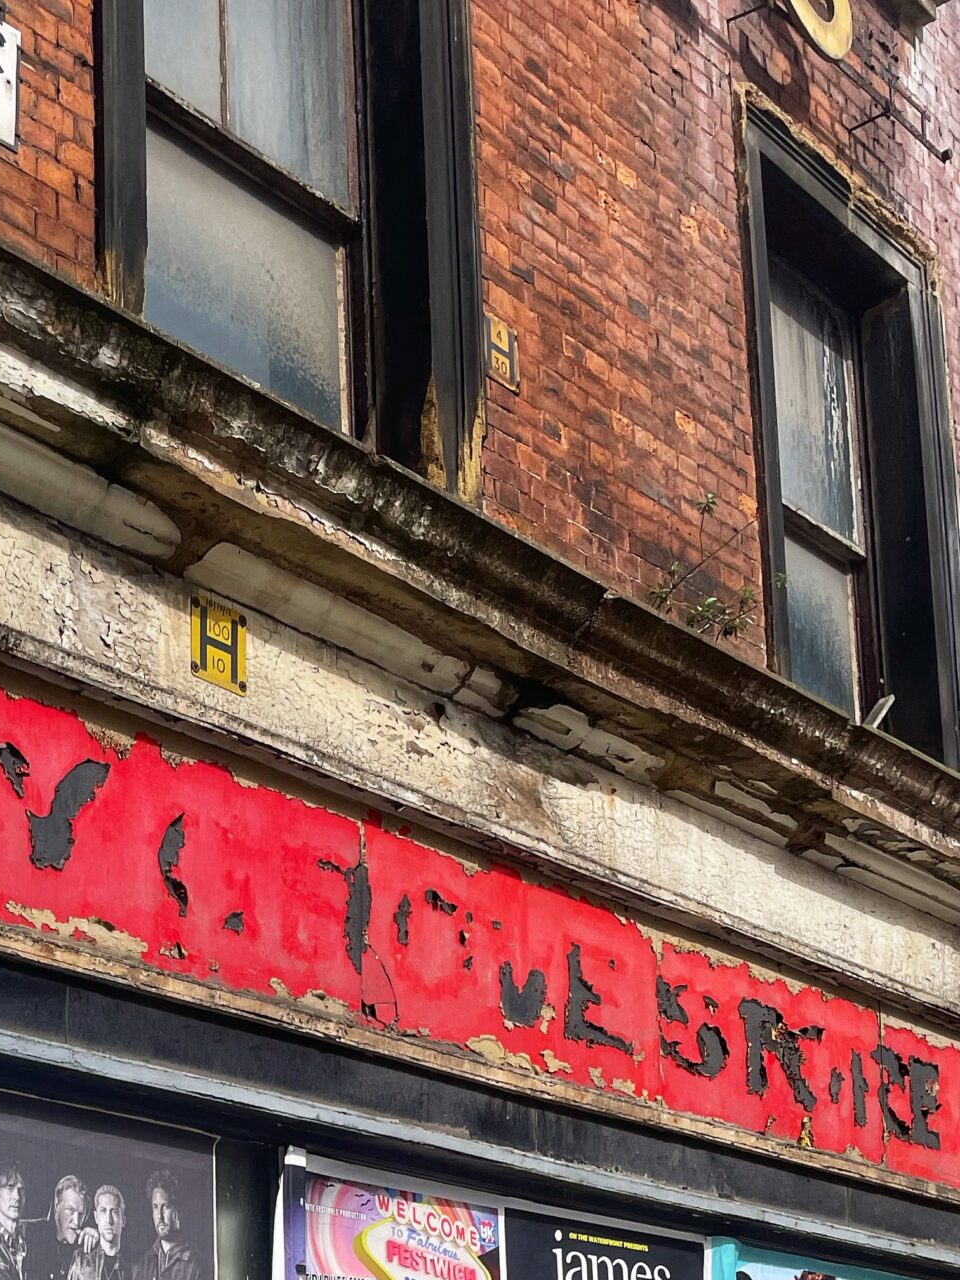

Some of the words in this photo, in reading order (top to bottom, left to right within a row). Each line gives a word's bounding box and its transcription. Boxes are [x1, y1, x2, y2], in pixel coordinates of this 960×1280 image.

[494, 356, 508, 376] 30
[208, 618, 230, 641] 100
[200, 606, 238, 685] H
[212, 655, 226, 674] 10
[377, 1195, 478, 1248] WELCOME
[390, 1226, 403, 1239] TO
[406, 1228, 460, 1261] Fabulous
[589, 1235, 623, 1248] WATERFRONT
[623, 1242, 649, 1252] PRESENTS
